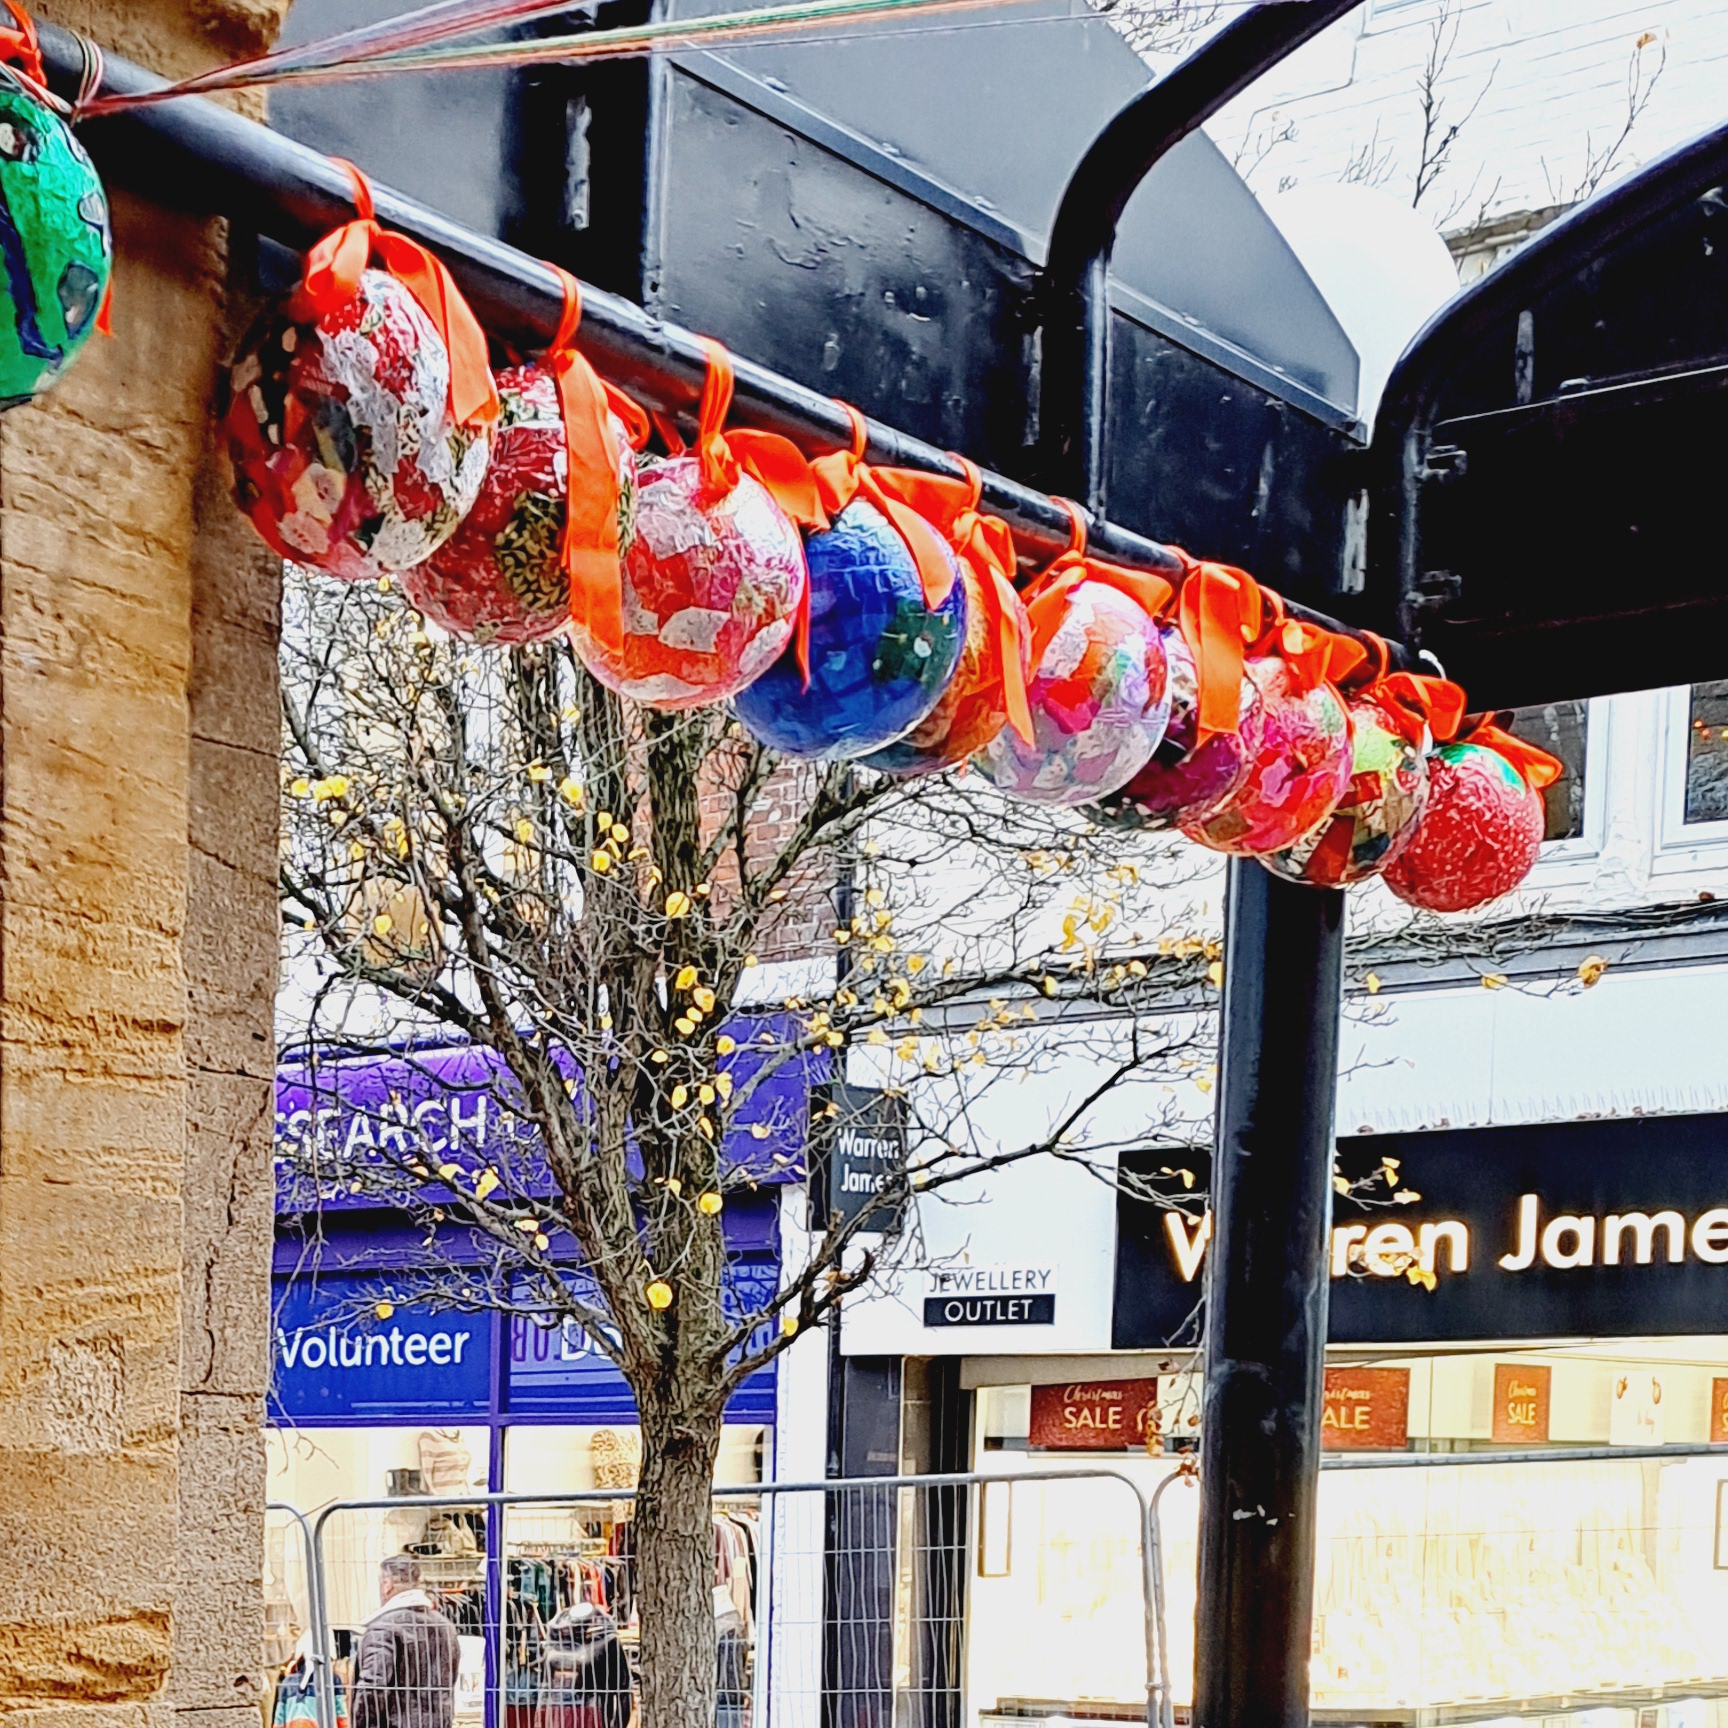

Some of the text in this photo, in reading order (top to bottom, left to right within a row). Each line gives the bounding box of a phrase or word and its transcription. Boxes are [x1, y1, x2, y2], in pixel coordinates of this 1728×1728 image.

[837, 1127, 900, 1159] Warren
[929, 1269, 1051, 1293] JEWELLERY
[944, 1299, 1033, 1322] OUTLET
[277, 1325, 470, 1368] Volunteer
[1063, 1406, 1123, 1430] SALE
[1321, 1405, 1372, 1430] ALE
[1507, 1402, 1537, 1425] SALE
